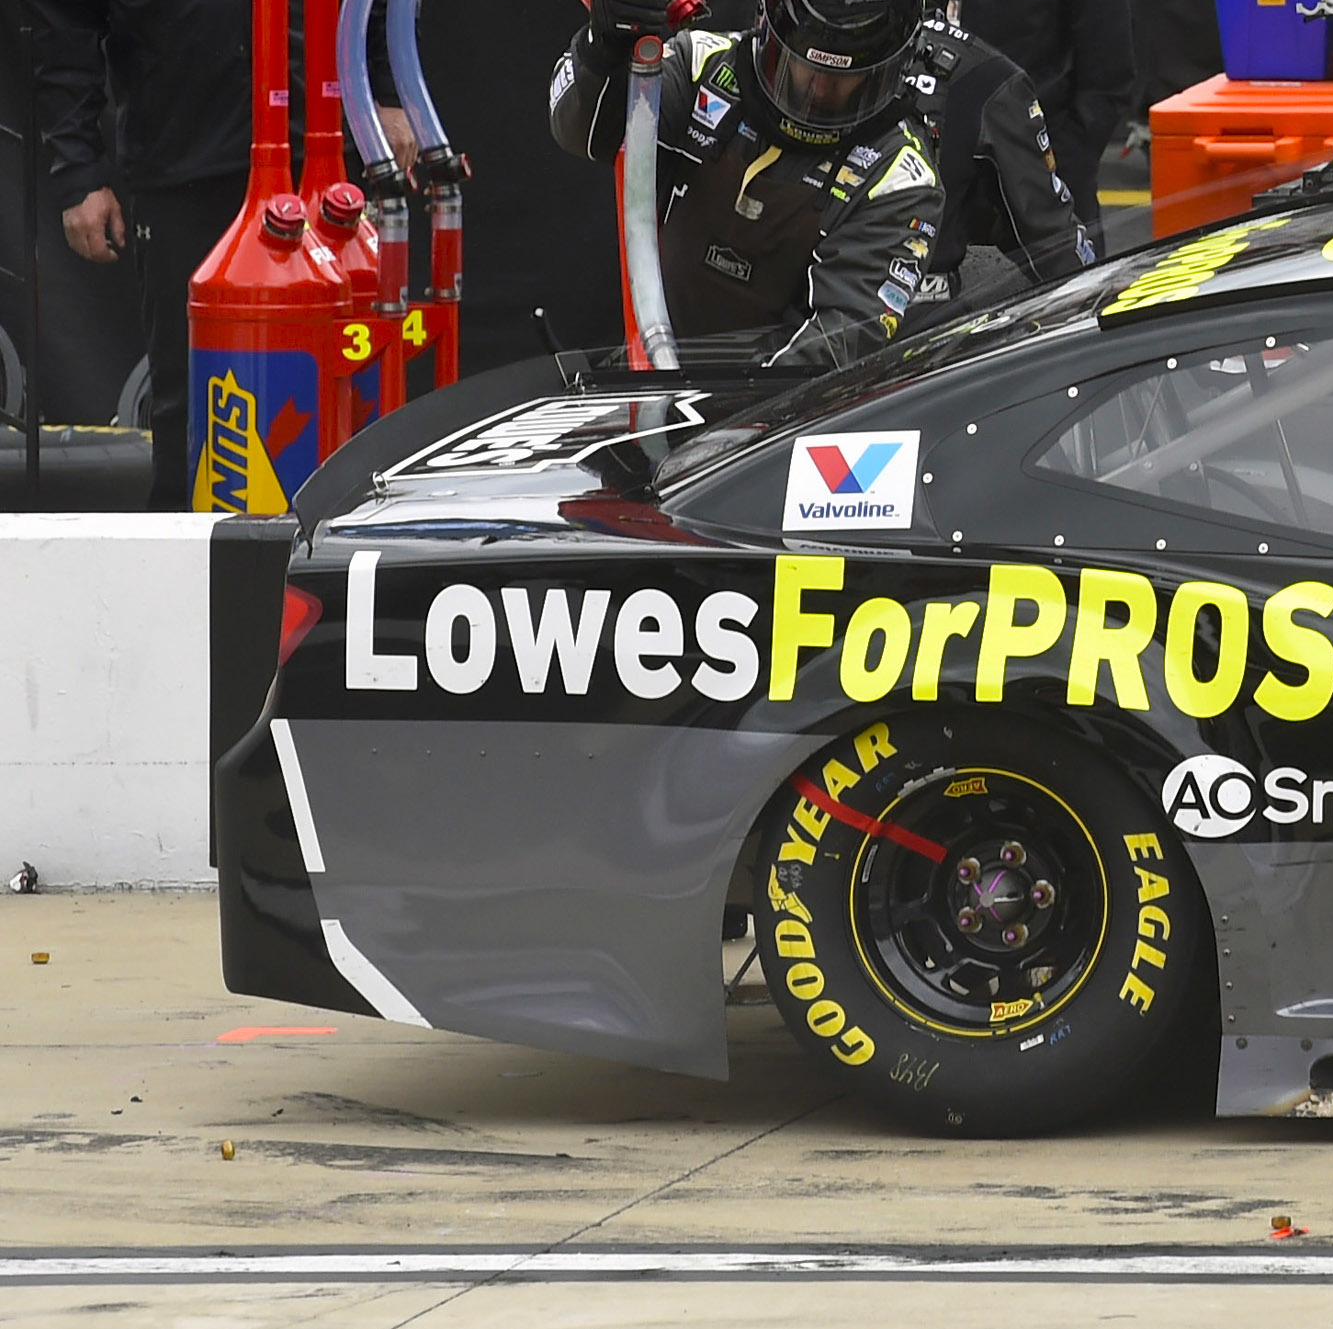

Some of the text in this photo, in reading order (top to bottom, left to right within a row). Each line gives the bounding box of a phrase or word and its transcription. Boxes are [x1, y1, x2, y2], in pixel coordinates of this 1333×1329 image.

[808, 51, 850, 67] SIMPSON
[402, 309, 427, 346] 4
[341, 323, 372, 361] 3
[799, 501, 895, 520] Valvoline
[1119, 832, 1171, 1016] EAGLE
[995, 1002, 1028, 1019] AERO
